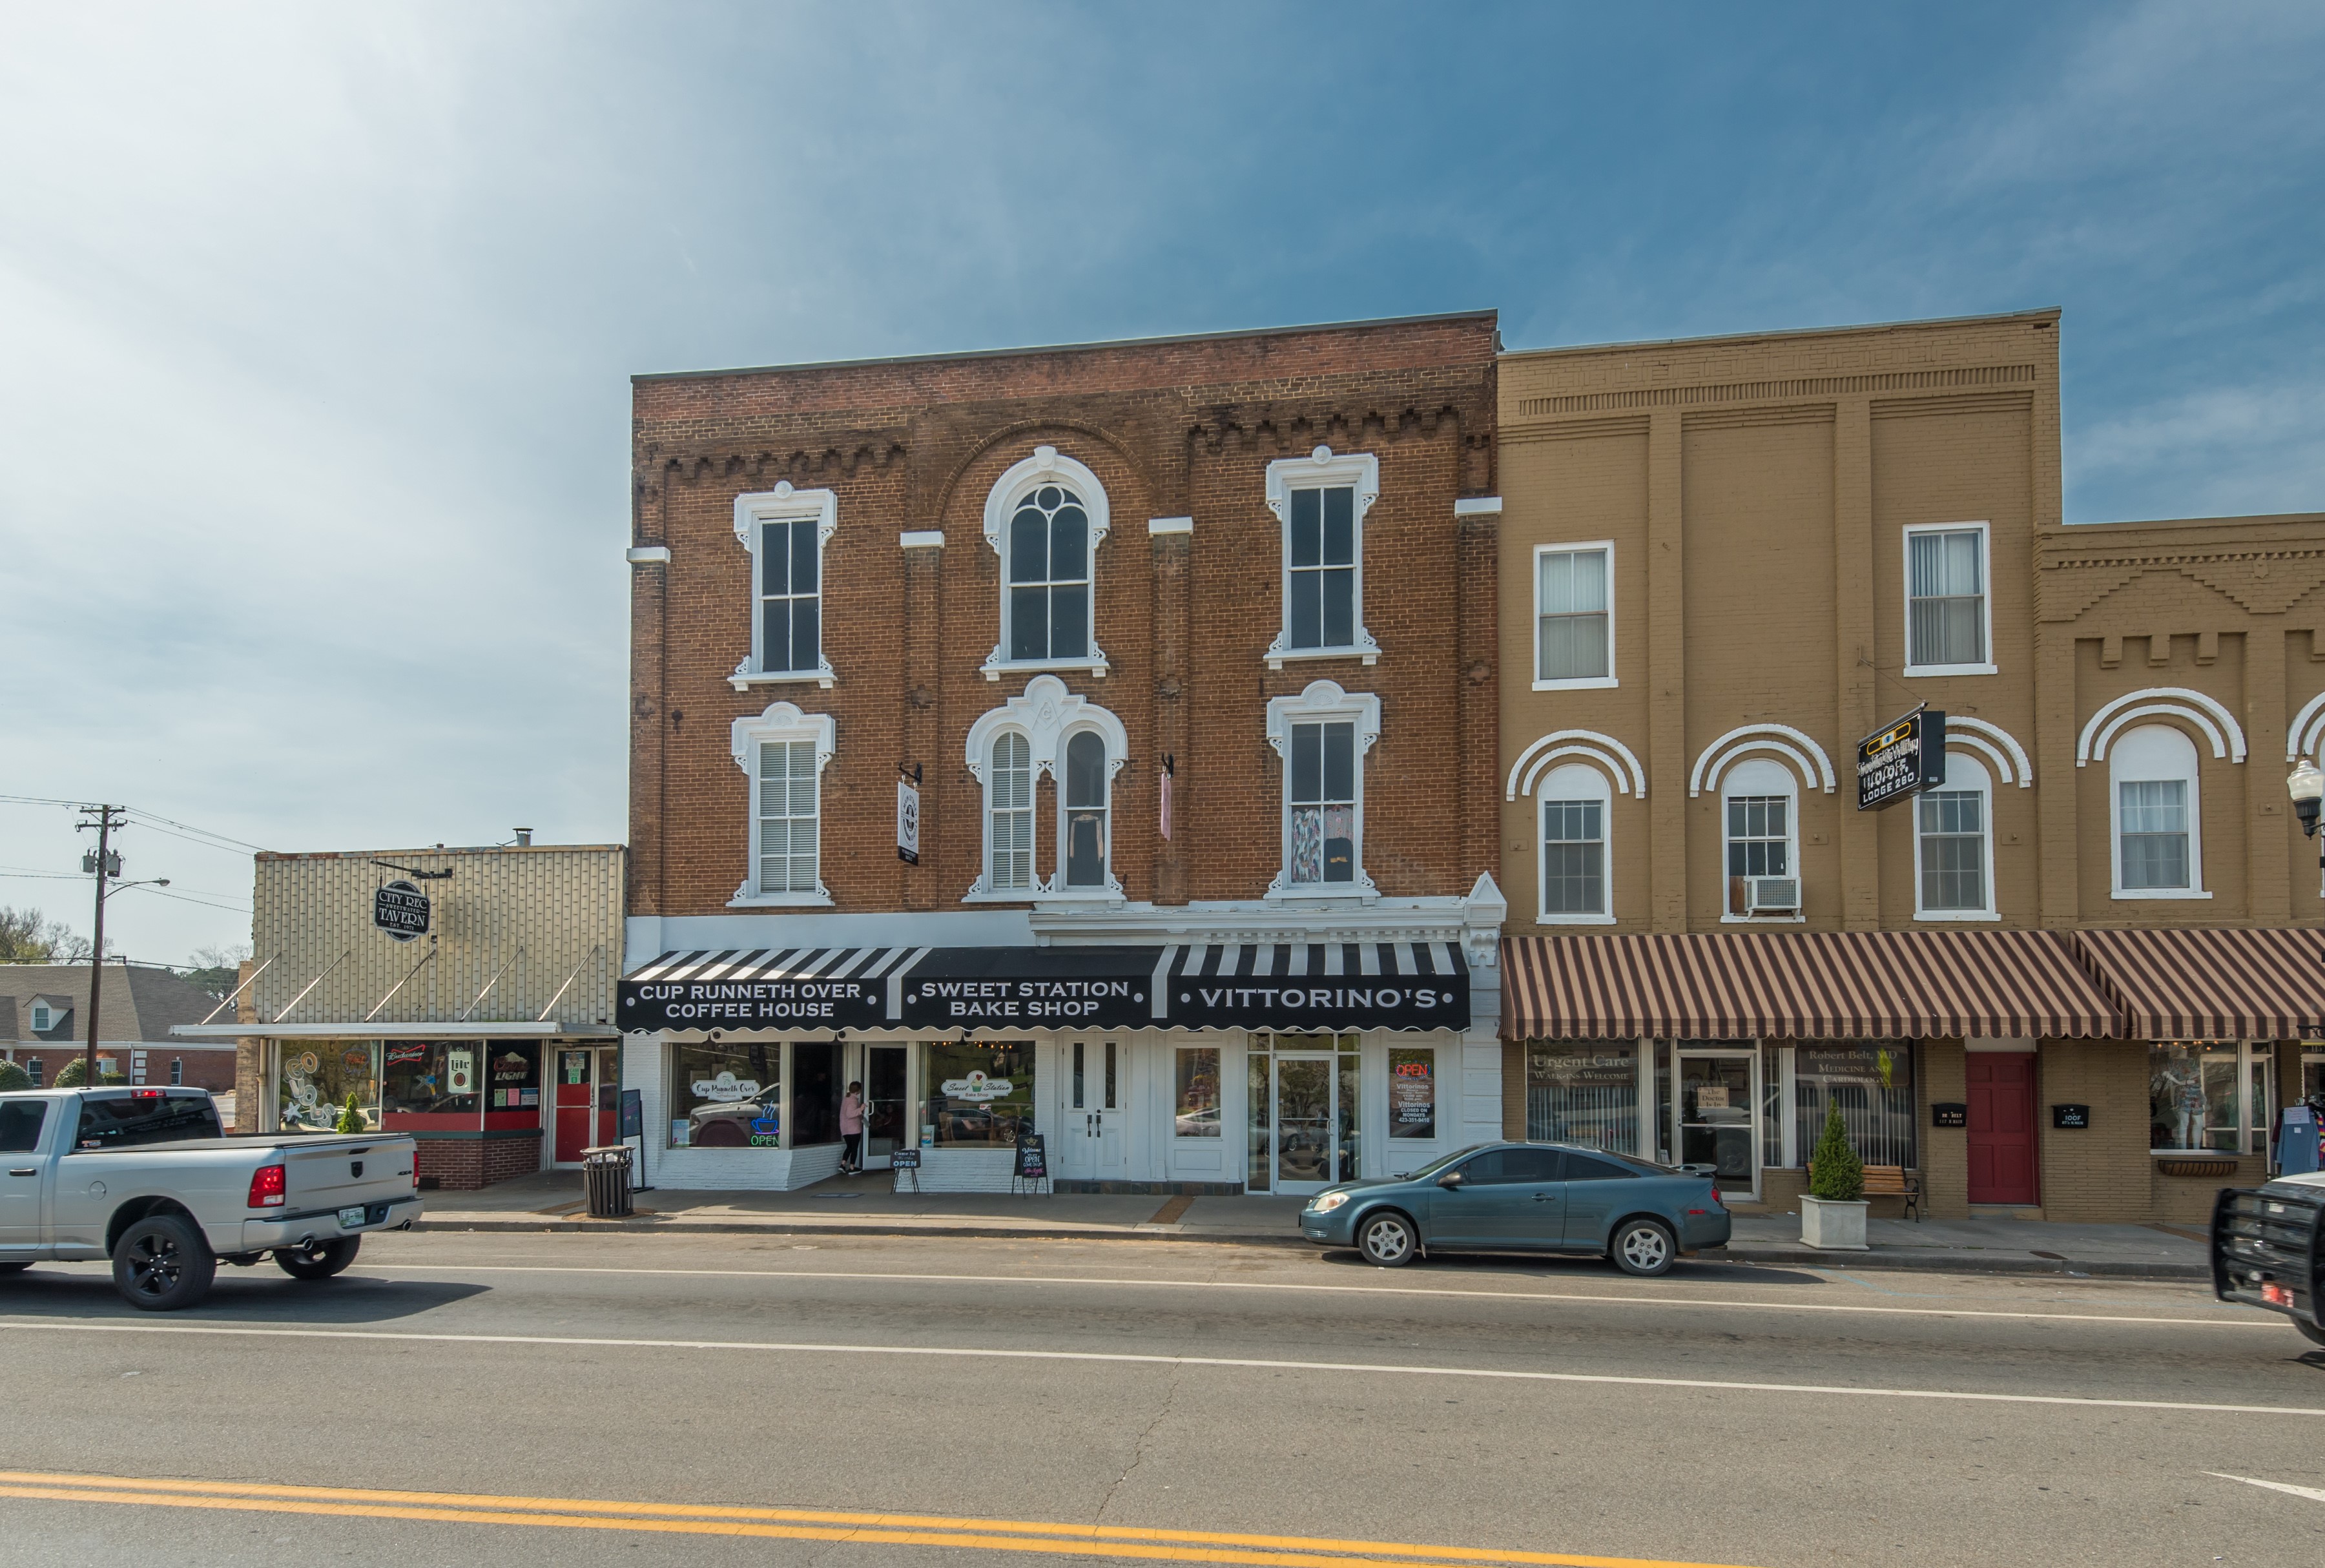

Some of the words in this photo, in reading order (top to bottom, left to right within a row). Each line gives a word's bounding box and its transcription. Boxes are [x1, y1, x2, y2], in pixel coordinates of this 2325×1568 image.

[1863, 781, 1892, 803] LODGE
[1895, 772, 1914, 789] 280
[379, 892, 402, 904] CITY
[406, 896, 427, 909] REC
[386, 903, 420, 913] SWEETWATER
[379, 907, 425, 927] TAVERN
[639, 985, 685, 1000] CUP
[691, 984, 796, 999] RUNNETH
[801, 984, 861, 998] OVER
[922, 982, 1011, 997] SWEET
[1018, 982, 1128, 996] STATION
[1199, 988, 1437, 1008] VITTORINO'S
[665, 1003, 752, 1018] COFFEE
[759, 1002, 834, 1017] HOUSE
[950, 1001, 1018, 1016] BAKE
[1028, 1001, 1099, 1016] SHOP
[386, 1051, 425, 1061] Budweiser
[1533, 1055, 1587, 1070] Urgent
[1592, 1054, 1629, 1067] Care
[1810, 1051, 1845, 1060] Robert
[1848, 1050, 1873, 1060] Belt,
[285, 1051, 318, 1080] GO
[450, 1058, 470, 1071] Lite
[1397, 1064, 1428, 1076] OPEN
[1819, 1064, 1866, 1073] MEDICINE
[495, 1071, 528, 1080] LIGHT
[1823, 1075, 1884, 1084] CARDIOLOGY
[696, 1083, 710, 1094] Cup
[712, 1084, 738, 1094] Runneth
[739, 1083, 754, 1093] Over
[947, 1083, 969, 1091] Sweet
[983, 1082, 1009, 1091] Station
[289, 1078, 336, 1128] VOLS
[751, 1135, 780, 1146] OPEN
